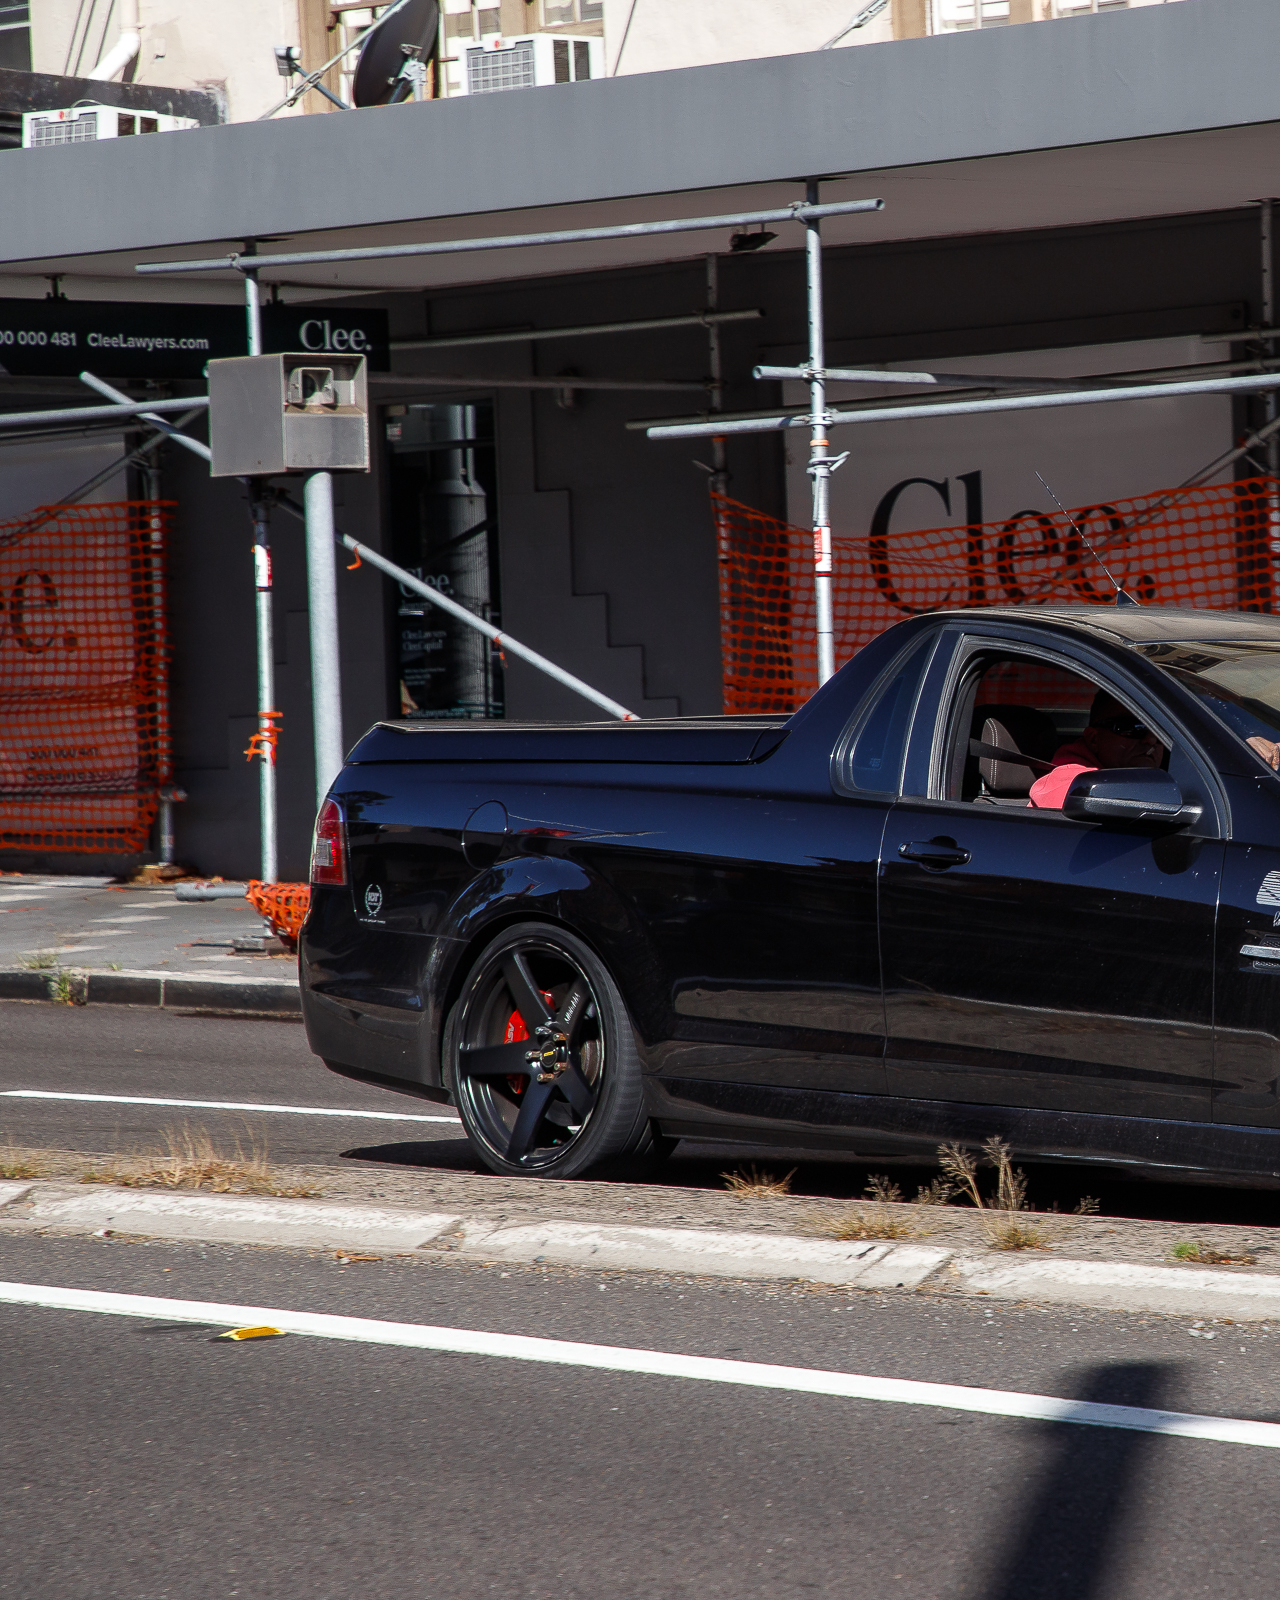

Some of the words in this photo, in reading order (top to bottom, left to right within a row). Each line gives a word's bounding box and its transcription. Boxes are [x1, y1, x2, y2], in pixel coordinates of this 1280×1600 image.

[17, 331, 48, 345] 000
[50, 332, 77, 346] 481
[87, 333, 210, 351] CleeLawyers.com
[300, 320, 372, 351] Clee.
[869, 469, 1156, 612] Clee.
